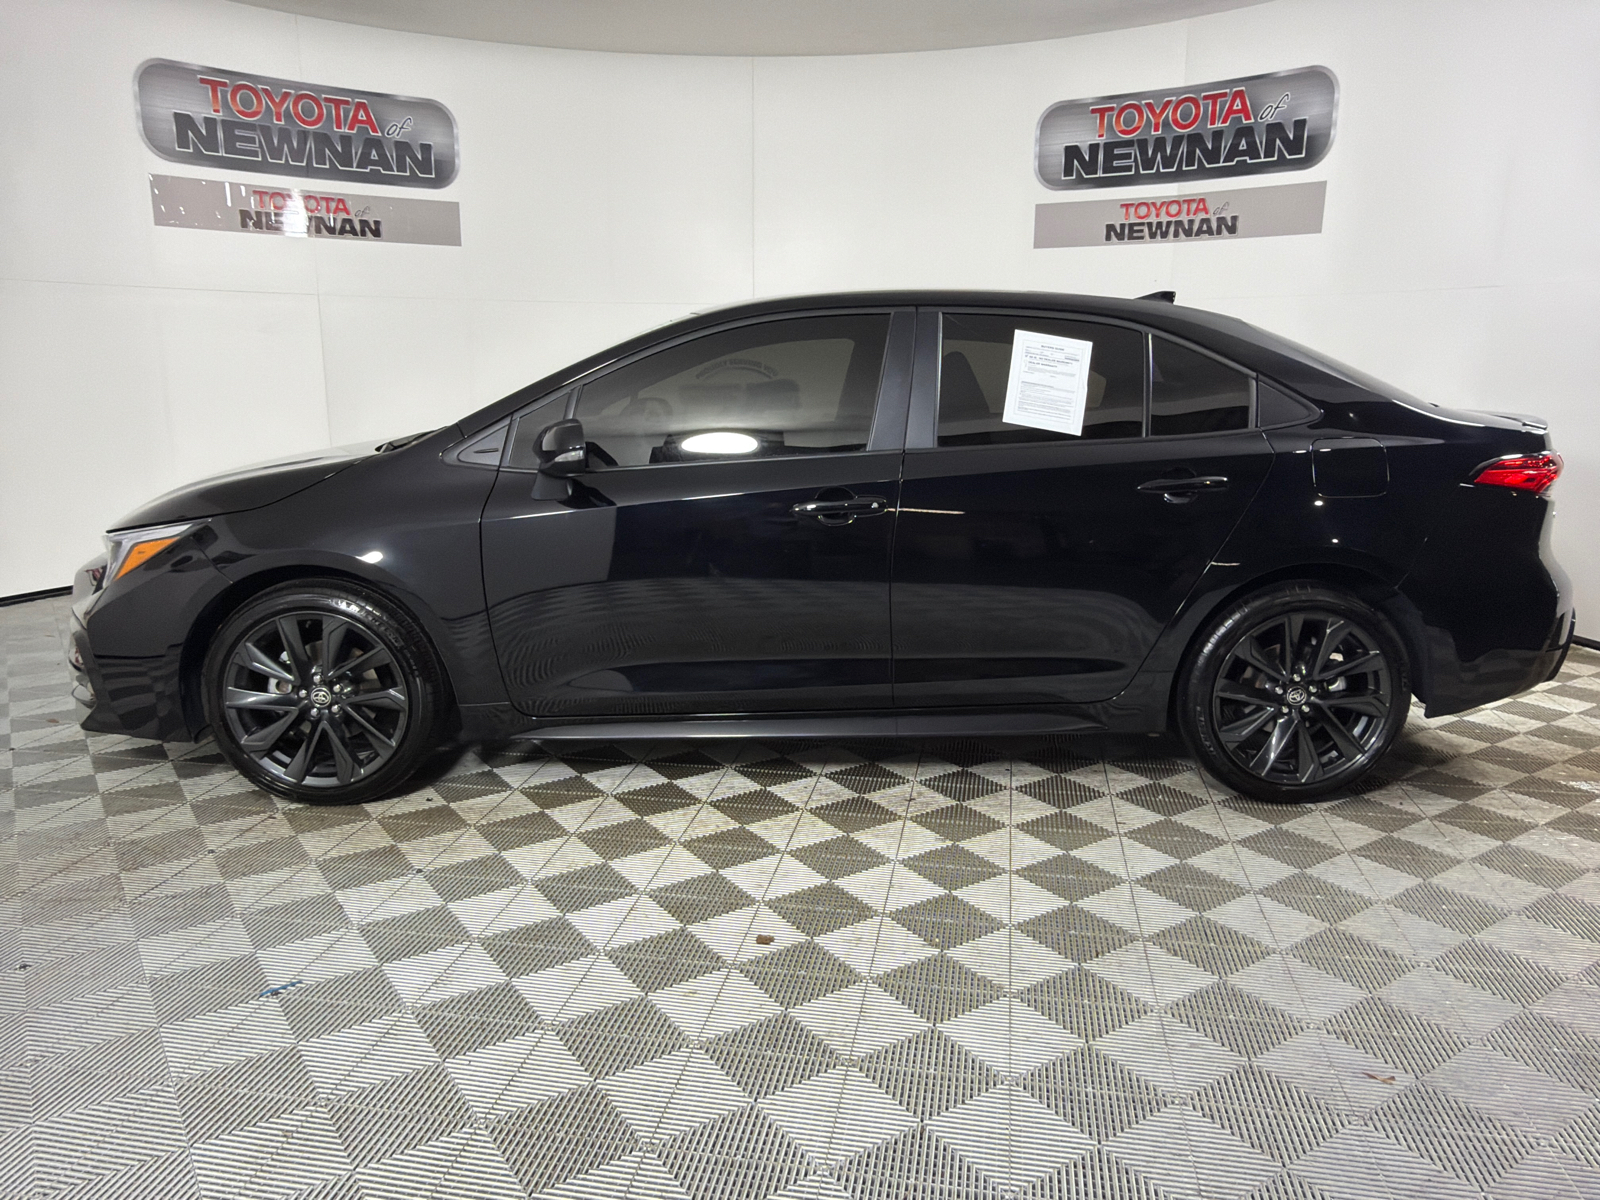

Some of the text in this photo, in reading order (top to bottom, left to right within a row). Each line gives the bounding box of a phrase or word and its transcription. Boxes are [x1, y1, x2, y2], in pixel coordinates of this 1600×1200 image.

[198, 75, 413, 138] TOYOTA of
[1090, 87, 1290, 139] TOYOTA of
[173, 111, 435, 178] NEWNAN
[1061, 117, 1308, 179] NEWNAN
[238, 209, 382, 238] NENAN
[252, 189, 371, 218] TOOTA of
[1120, 197, 1230, 221] TOYOTA of
[1104, 214, 1239, 242] NEWNAN
